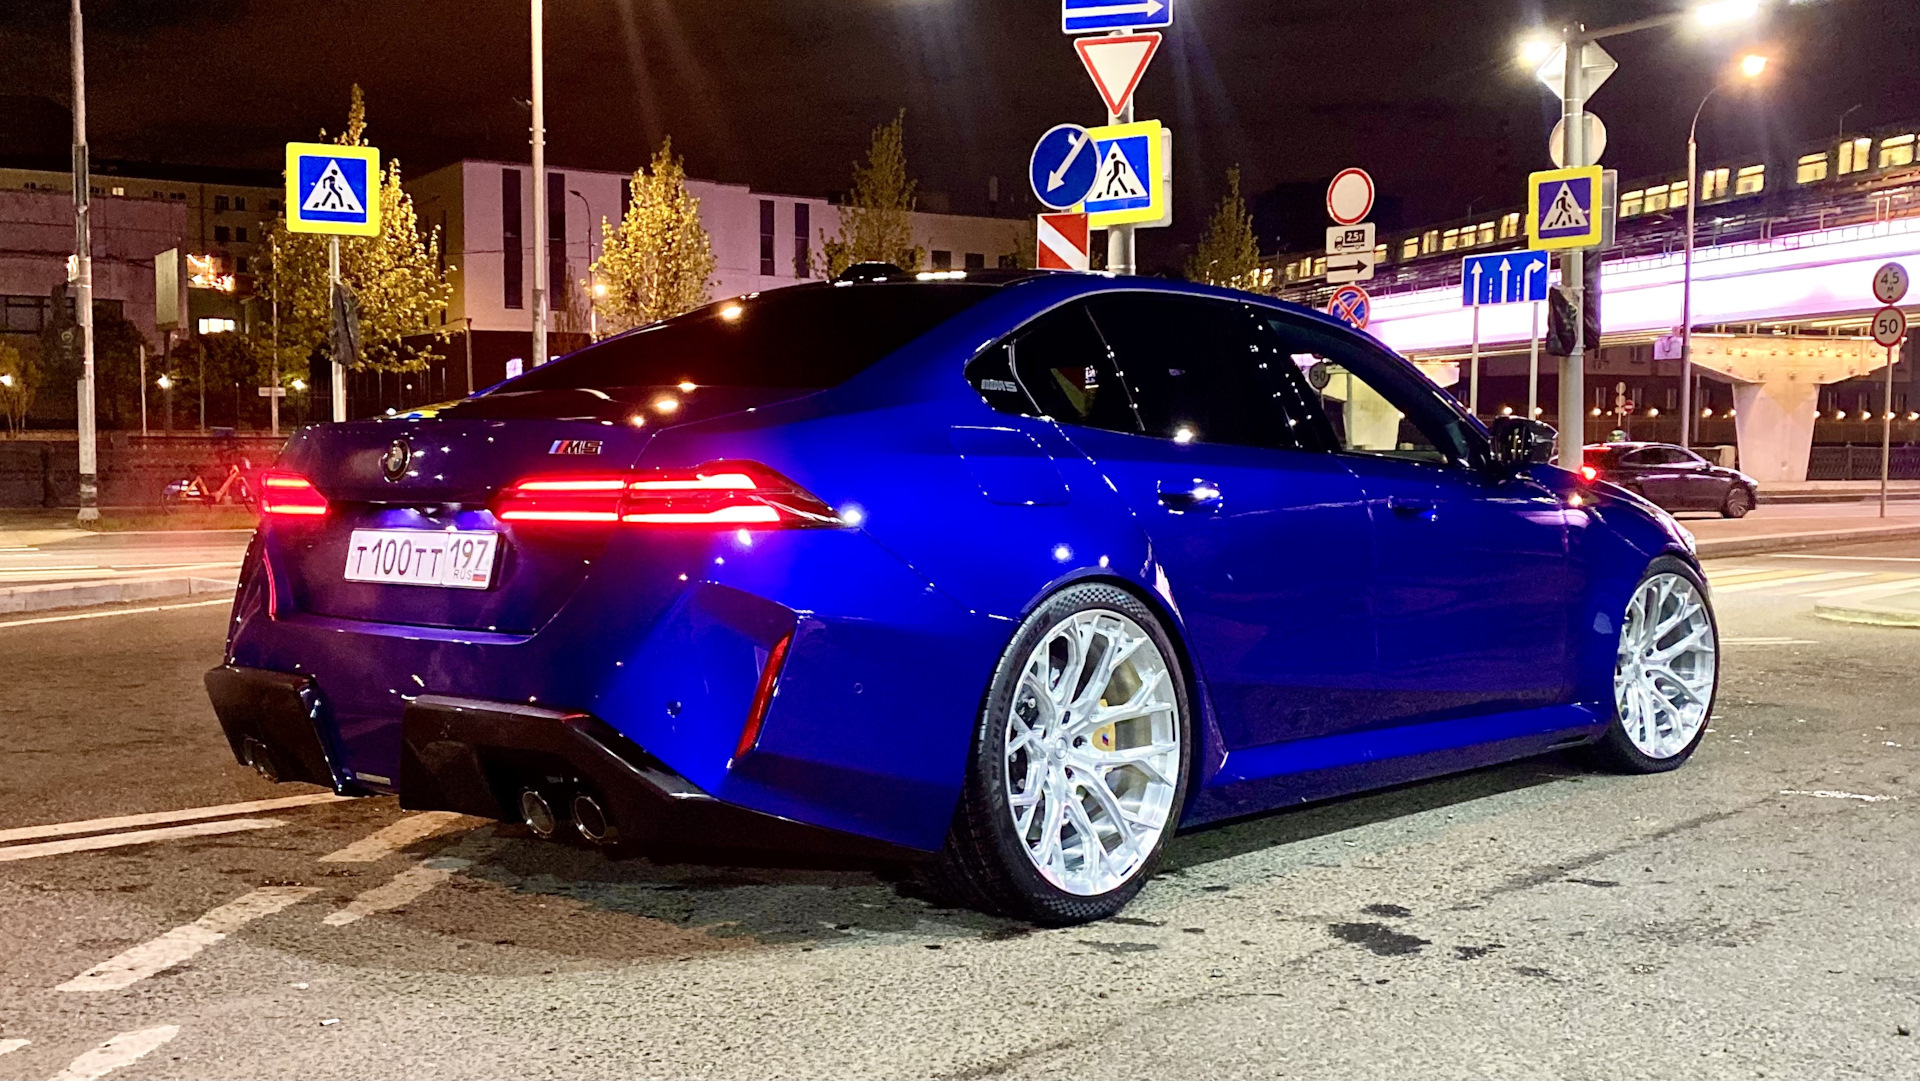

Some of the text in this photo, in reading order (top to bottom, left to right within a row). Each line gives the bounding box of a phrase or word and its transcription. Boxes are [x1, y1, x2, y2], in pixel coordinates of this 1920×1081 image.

[1879, 318, 1898, 335] 50
[1313, 370, 1326, 380] 50
[563, 440, 603, 455] M5
[356, 538, 489, 578] Т100ТТ 197
[453, 568, 472, 580] RUS
